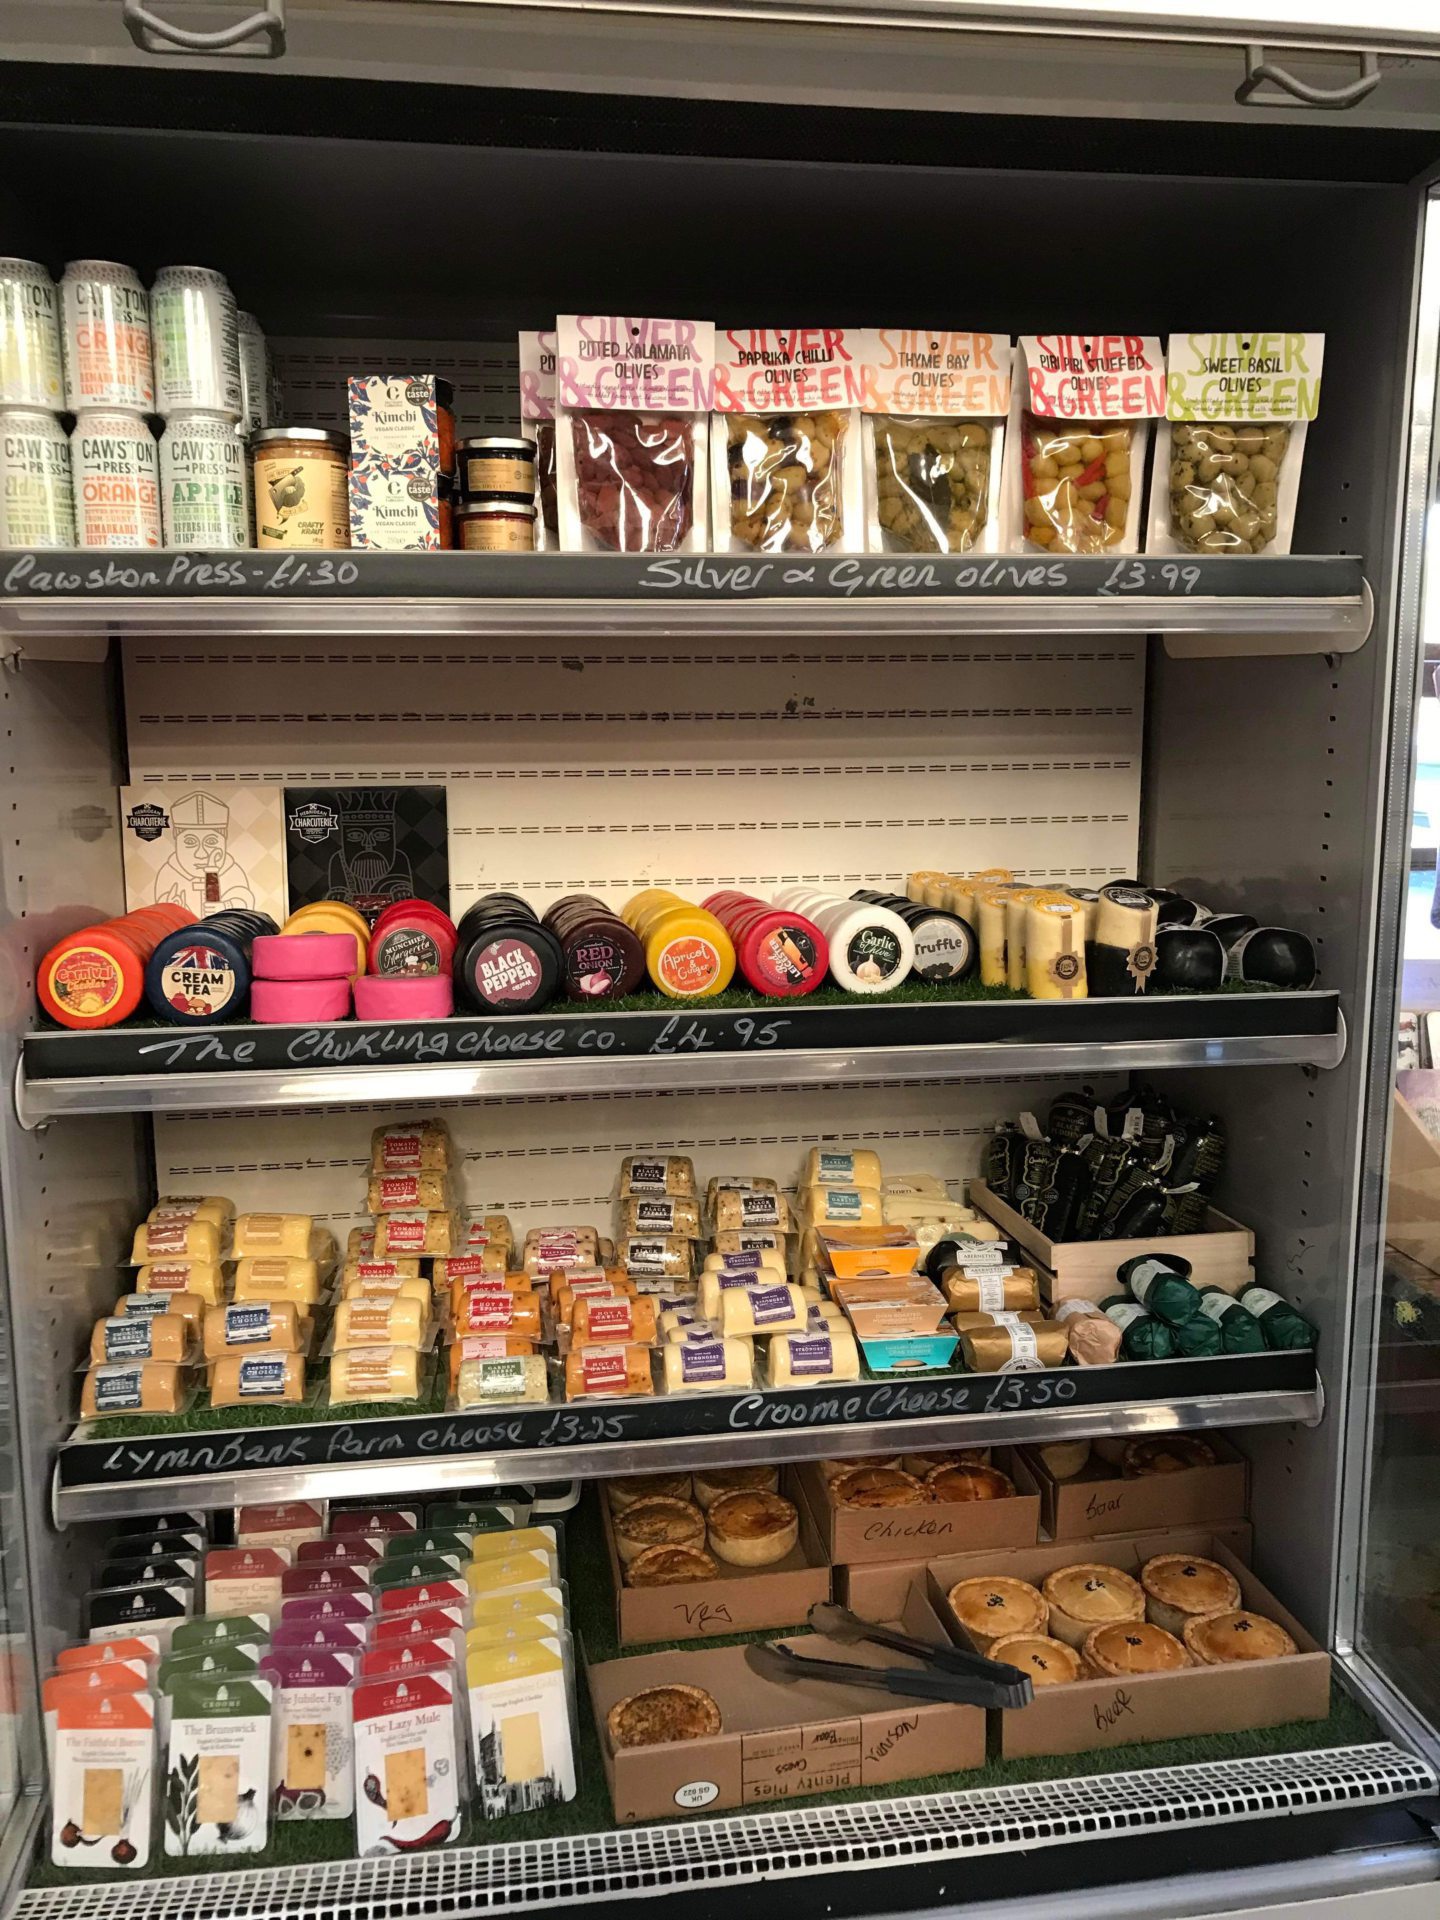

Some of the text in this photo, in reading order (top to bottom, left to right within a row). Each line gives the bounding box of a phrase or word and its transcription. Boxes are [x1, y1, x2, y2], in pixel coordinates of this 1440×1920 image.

[76, 284, 147, 314] CASTON
[576, 315, 702, 363] SILVER
[580, 340, 690, 360] PITTED KALAMATA
[727, 329, 852, 368] SILVER
[738, 348, 832, 365] PAPRIKA CHILLI
[879, 329, 999, 370] SILVER
[1037, 336, 1153, 373] SILVER
[1187, 333, 1309, 376] SILVER
[899, 352, 969, 369] THYME BAY
[1040, 354, 1145, 372] PIRI PIRI STUFFED
[1203, 357, 1283, 373] SWEET BASIL
[615, 362, 659, 379] OLIVES
[765, 368, 808, 383] OLIVES
[559, 356, 592, 408] &
[595, 366, 715, 410] GREEN
[715, 363, 745, 413] &
[748, 364, 866, 409] GREEN
[912, 372, 954, 387] OLIVES
[1071, 376, 1111, 391] OLIVES
[1219, 377, 1262, 392] OLIVES
[407, 390, 429, 398] taste
[861, 364, 890, 413] &
[895, 374, 1010, 414] GREEN
[1029, 367, 1166, 417] & GREEN
[1166, 372, 1321, 421] & GREEN
[372, 410, 417, 425] Kimchi
[82, 439, 153, 463] CAWSTON
[171, 441, 240, 464] CAWSTON
[29, 461, 60, 475] PRSS
[192, 463, 225, 475] PRESS
[83, 482, 157, 505] ORANGE
[172, 482, 243, 506] APPLE
[408, 486, 431, 494] taste
[372, 505, 418, 519] Kimchi
[298, 521, 324, 529] CRAFTY
[300, 528, 324, 536] KRAUT
[263, 559, 358, 590] £1.30
[638, 559, 773, 591] Silver
[828, 558, 942, 597] Green
[1099, 558, 1202, 597] £3.99
[129, 817, 167, 827] CHARCUTERIE
[295, 817, 333, 827] CHARCUTERIE
[385, 934, 427, 953] MUNCHIES
[861, 930, 896, 951] Garlic
[914, 937, 963, 956] Truffle
[576, 945, 614, 962] RED
[663, 943, 710, 970] Apricot
[768, 938, 801, 979] LEICESTER
[480, 948, 525, 979] BLACK
[578, 959, 613, 970] ONION
[677, 963, 710, 980] Ginger
[689, 960, 696, 968] &
[56, 966, 114, 984] Carnival
[171, 971, 223, 984] CREAM
[482, 961, 537, 995] PEPPER
[183, 984, 211, 996] TEA
[138, 1033, 256, 1065] The
[649, 1015, 792, 1053] £4.95
[755, 1297, 786, 1305] STRONGEST
[232, 1316, 264, 1325] CHOICE
[246, 1368, 279, 1376] CHOICE
[728, 1393, 859, 1429] Croome
[984, 1374, 1077, 1416] £3.50
[537, 1411, 639, 1449] £3.25
[120, 1606, 157, 1616] CROOME
[310, 1611, 345, 1620] CROOME
[672, 1602, 734, 1632] Veg
[389, 1659, 427, 1671] CROOME
[202, 1700, 240, 1708] CROOME
[293, 1692, 342, 1706] Jubilee Fig
[382, 1694, 421, 1706] CROOME
[183, 1723, 256, 1735] The Brunswick
[364, 1712, 441, 1736] The Lazy Mule
[753, 1772, 851, 1797] Plenty Pies
[691, 1795, 703, 1803] UK
